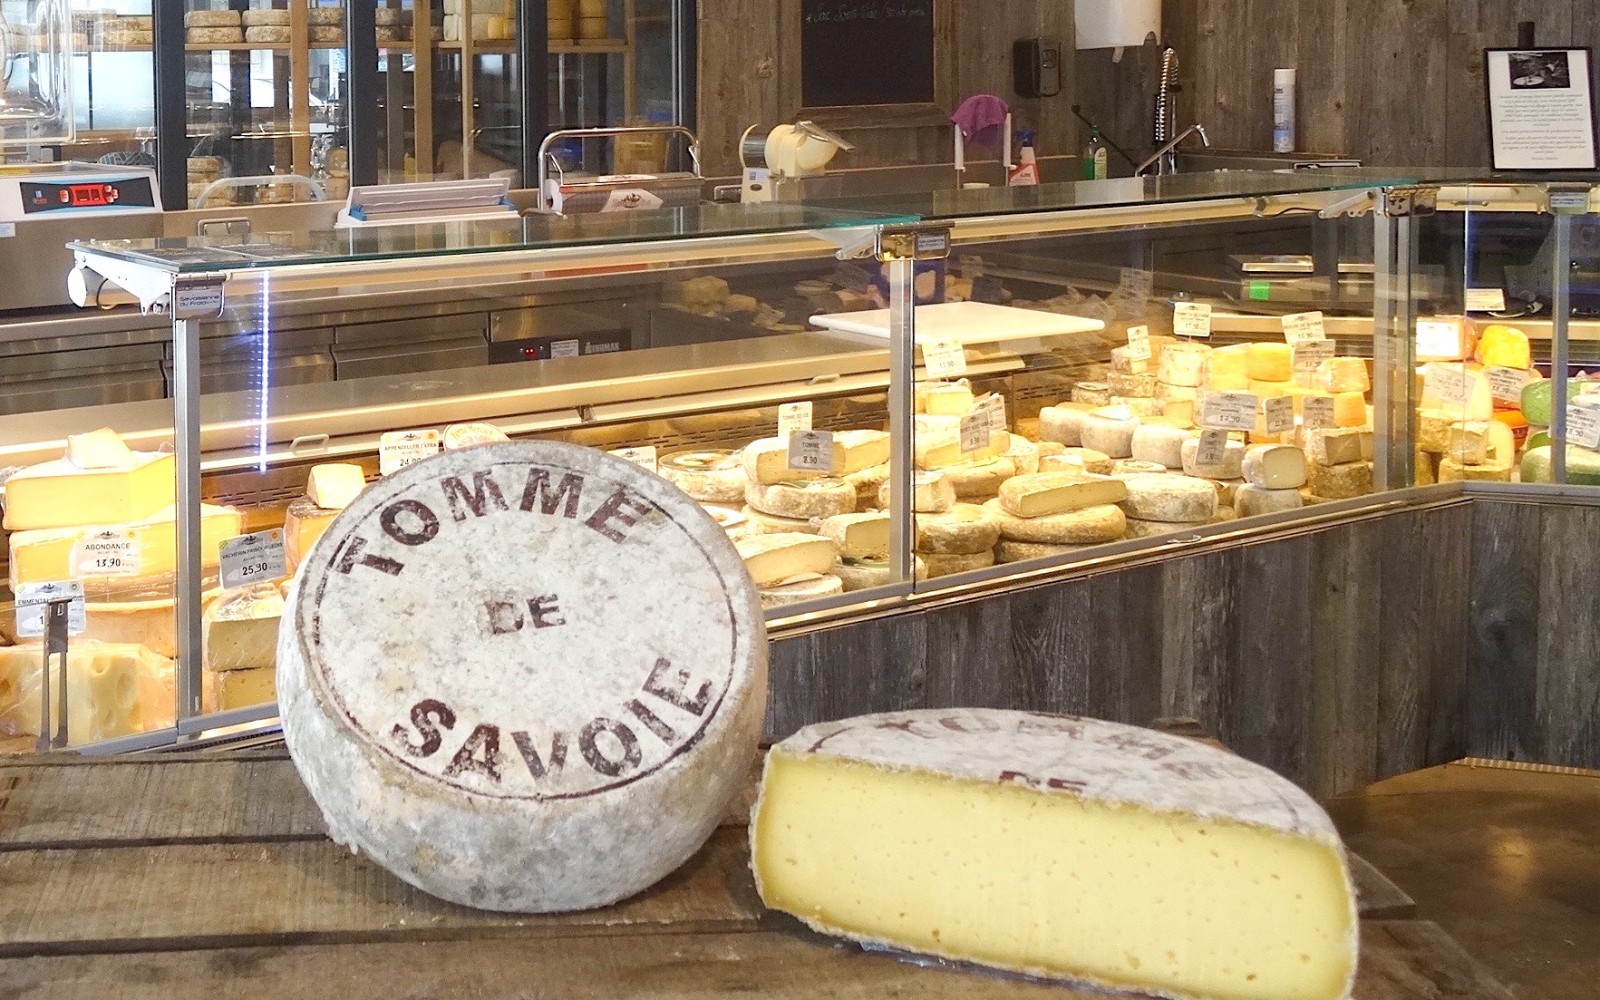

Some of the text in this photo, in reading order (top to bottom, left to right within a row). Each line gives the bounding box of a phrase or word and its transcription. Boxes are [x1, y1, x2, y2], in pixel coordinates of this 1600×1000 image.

[802, 441, 820, 449] TOMME
[335, 467, 652, 576] TOMME
[85, 542, 131, 551] ABONDANCE
[222, 549, 247, 559] VACHERIN
[246, 542, 283, 554] FRIBOURGEOIS
[485, 593, 566, 635] DE
[392, 657, 712, 784] SAVOIE
